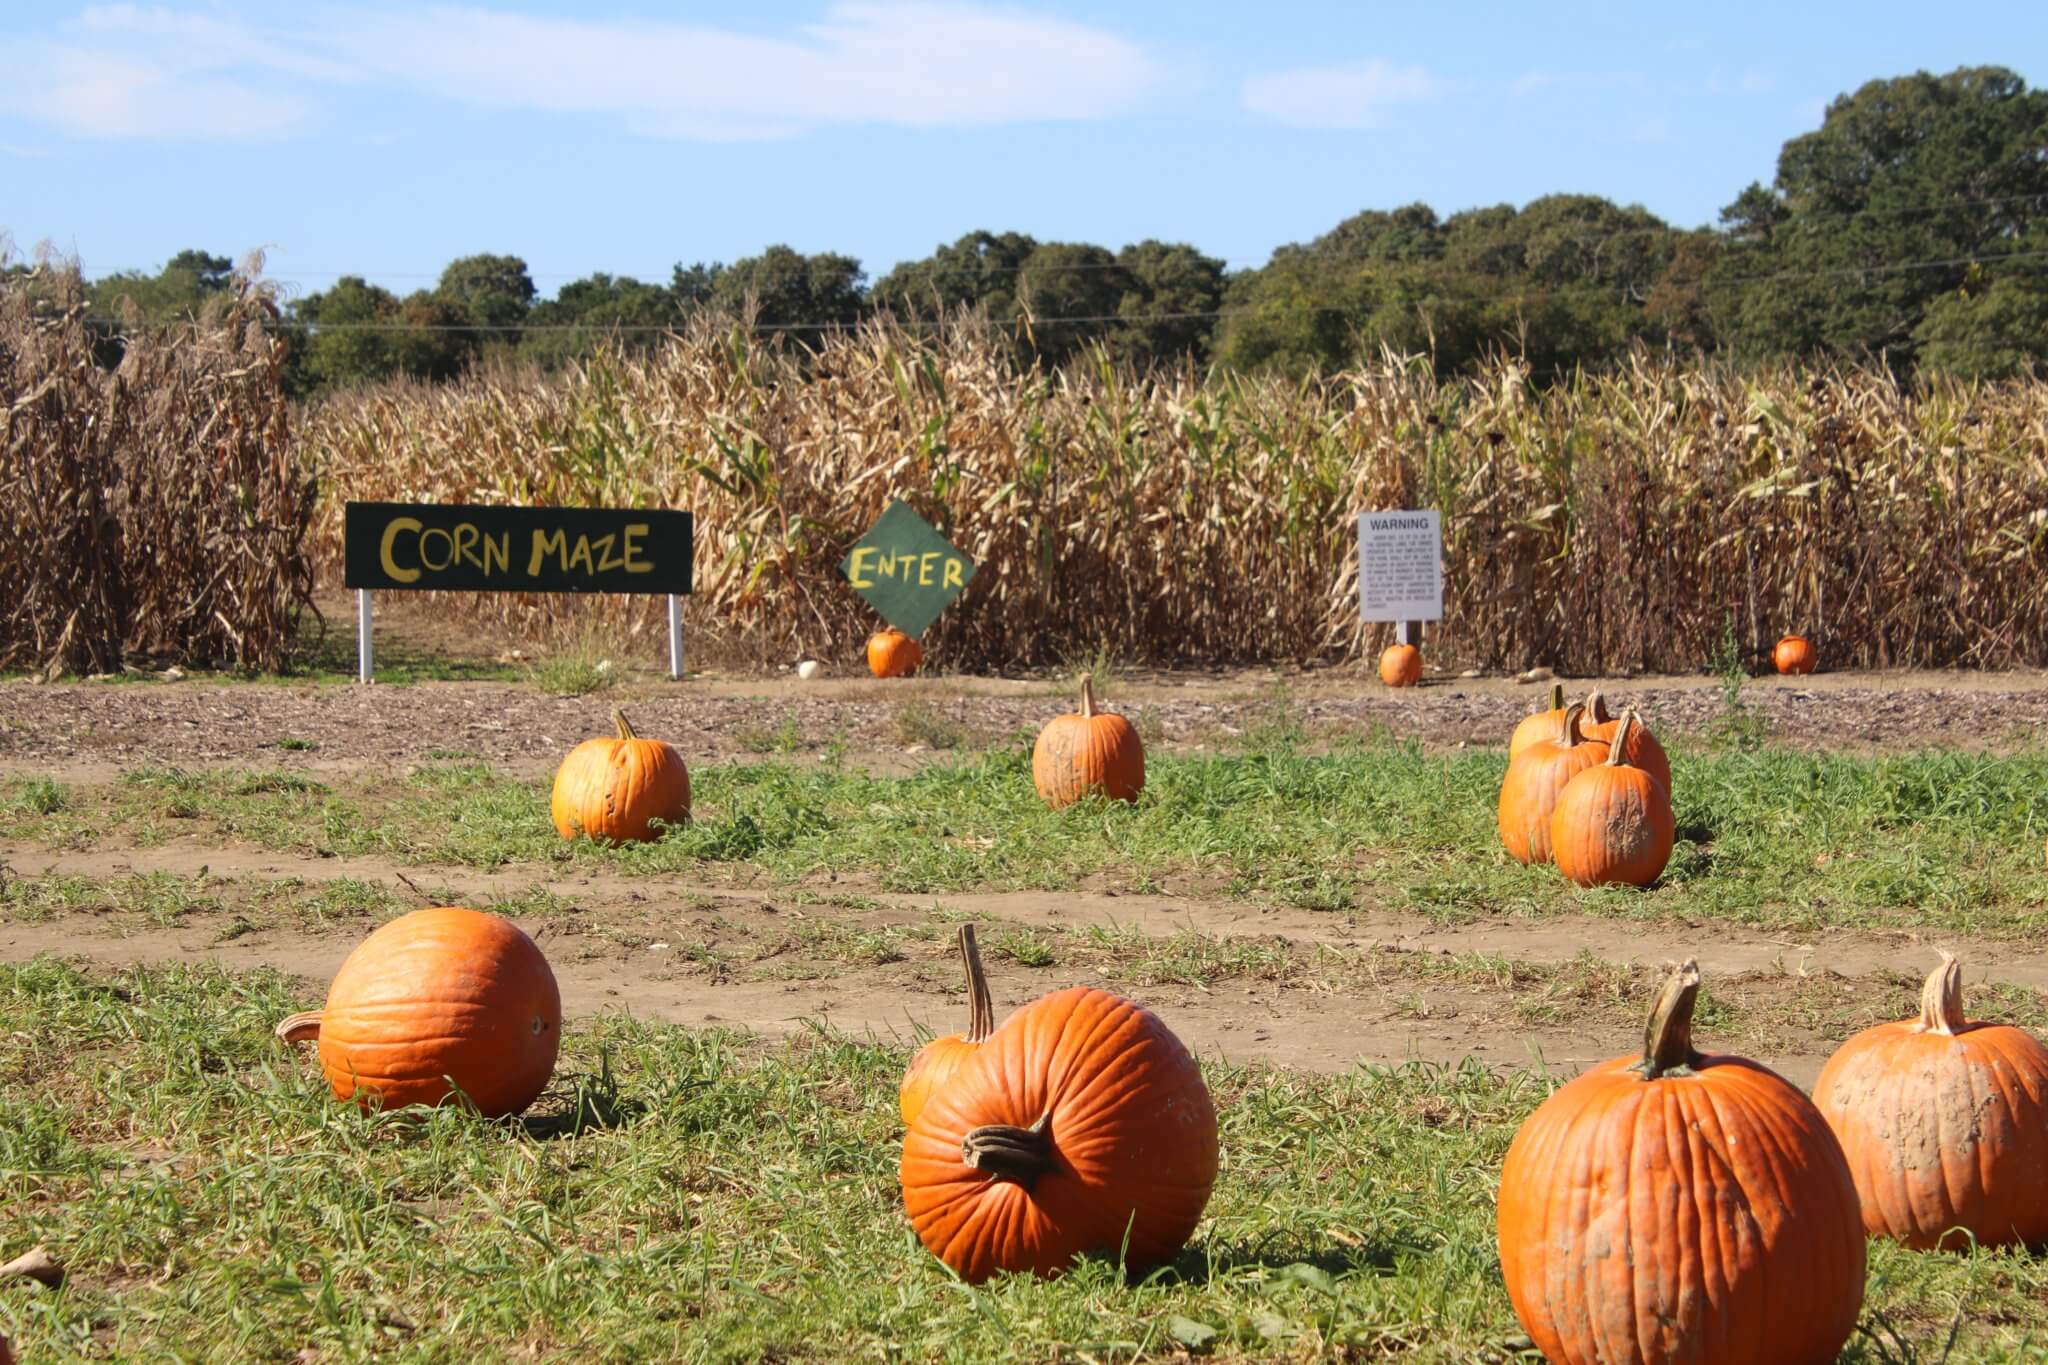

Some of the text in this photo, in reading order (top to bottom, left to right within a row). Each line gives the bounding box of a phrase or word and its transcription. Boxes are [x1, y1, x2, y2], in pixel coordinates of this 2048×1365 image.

[1370, 518, 1429, 531] WARNING
[380, 517, 654, 583] CORN MAZE
[848, 547, 963, 589] ENTER
